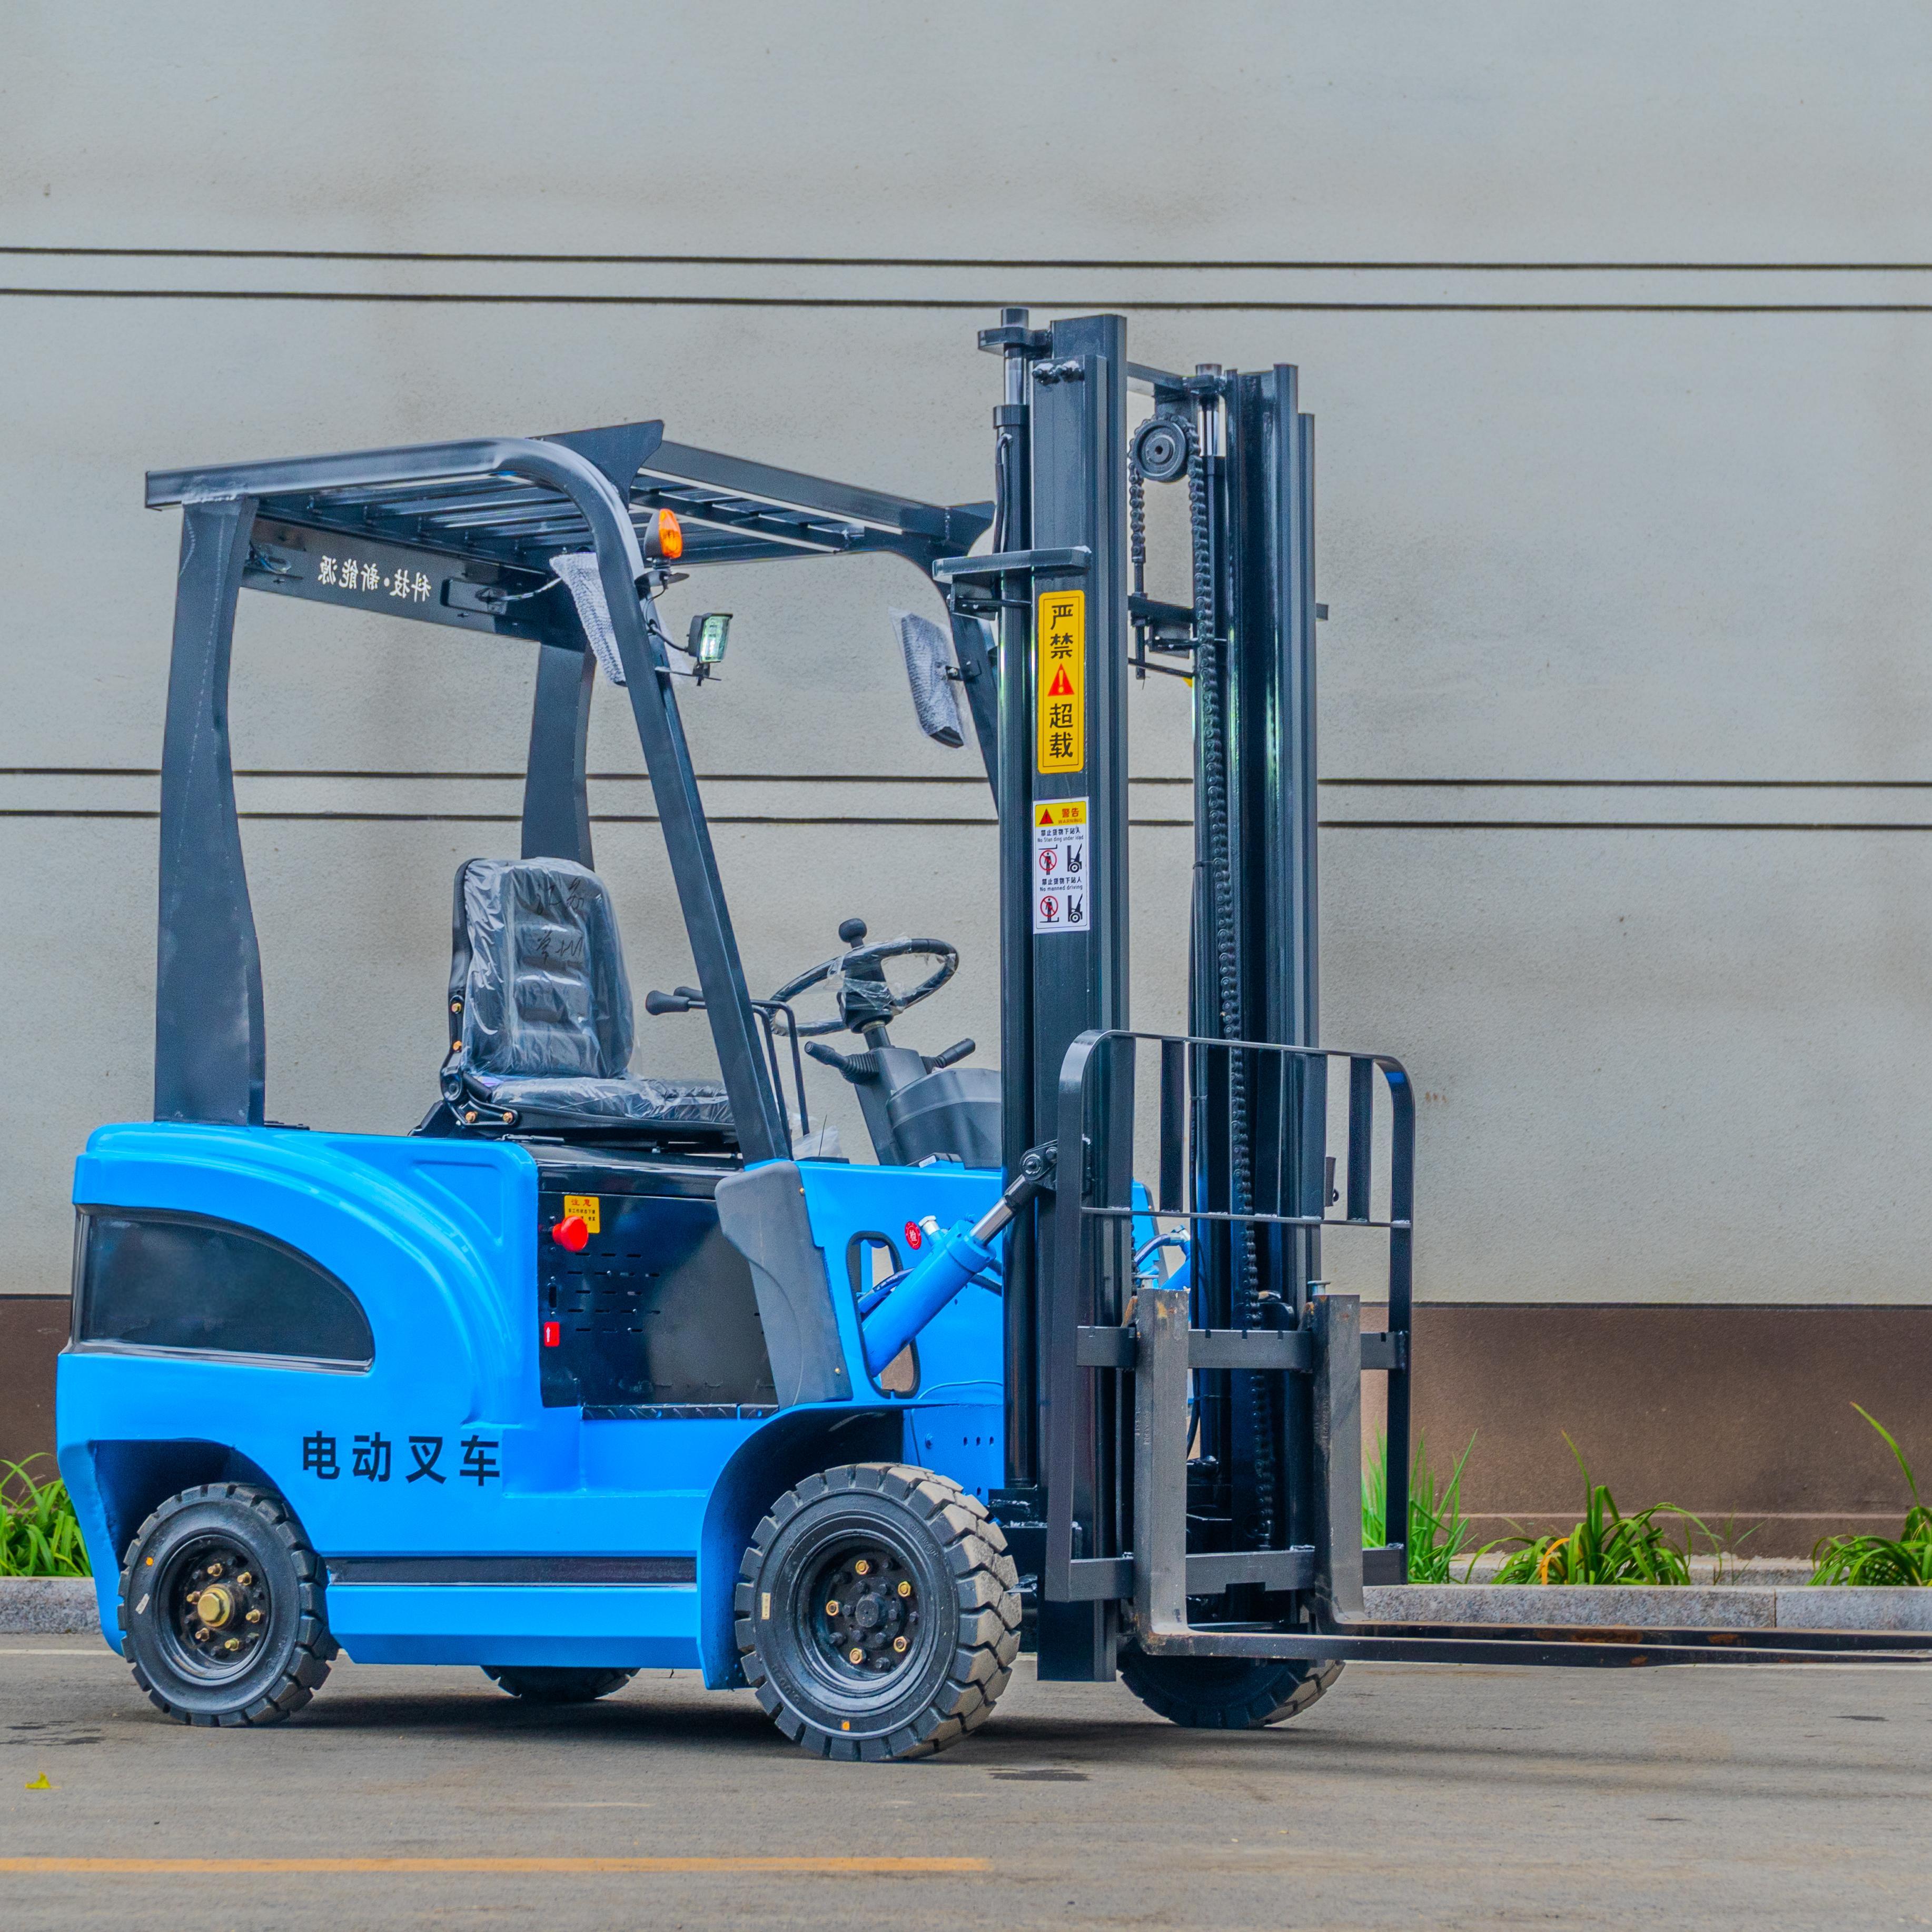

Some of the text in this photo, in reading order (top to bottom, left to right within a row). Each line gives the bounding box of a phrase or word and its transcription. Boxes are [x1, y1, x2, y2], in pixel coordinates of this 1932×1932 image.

[1049, 603, 1074, 759] 严禁 超载
[1062, 808, 1079, 818] 警告
[571, 1198, 592, 1207] 注意
[302, 1430, 500, 1487] 电动叉车
